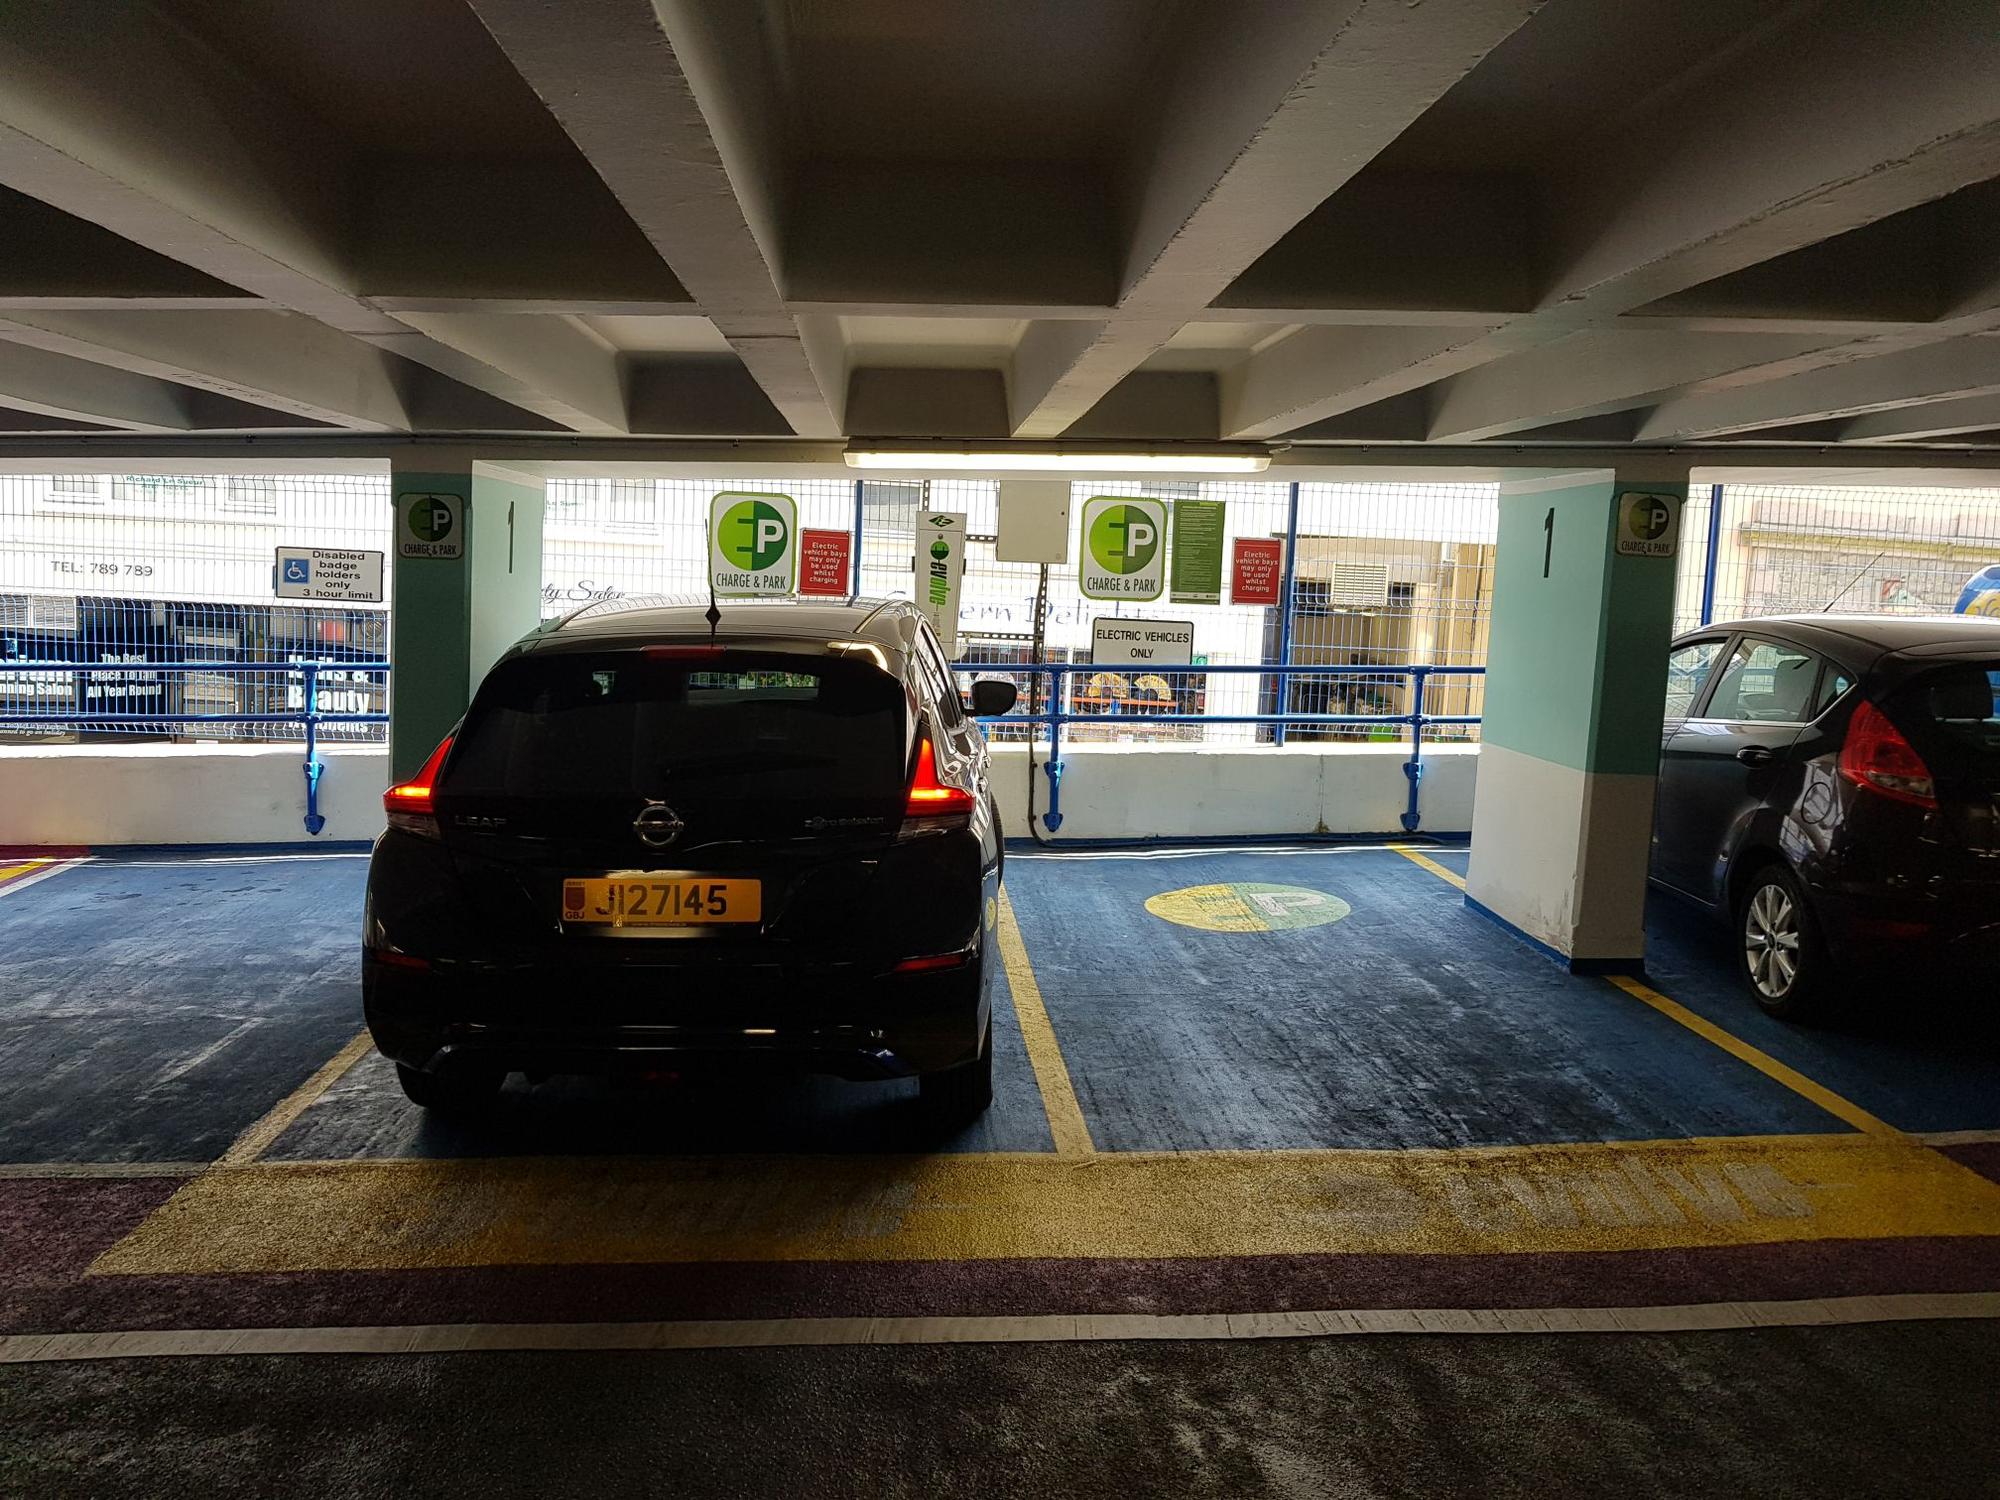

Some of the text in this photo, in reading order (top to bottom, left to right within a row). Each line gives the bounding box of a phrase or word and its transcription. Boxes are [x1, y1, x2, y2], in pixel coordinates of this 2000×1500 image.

[508, 501, 514, 574] 1
[812, 542, 839, 550] Electric
[1544, 508, 1555, 578] 1
[1622, 540, 1646, 552] CHARGE
[1654, 543, 1670, 554] PARK
[404, 544, 457, 555] CHARGE & PARK
[830, 550, 847, 558] bays
[312, 551, 365, 560] Disabled
[50, 561, 153, 576] TEL: 789 789
[320, 561, 357, 571] badge
[1257, 564, 1272, 572] only
[316, 570, 360, 580] holders
[809, 576, 838, 584] charging
[325, 581, 351, 590] only
[716, 573, 786, 589] CHARGE & PARK
[929, 560, 951, 606] evolve
[1087, 576, 1156, 592] CHARGE & PARK
[316, 590, 342, 598] hour
[348, 591, 373, 599] limit
[1096, 629, 1189, 643] ELECTRIC VEHICLES
[1130, 648, 1154, 658] ONLY
[36, 682, 72, 696] Salon
[104, 686, 126, 696] Year
[128, 684, 162, 696] Round
[565, 911, 584, 920] GBJ
